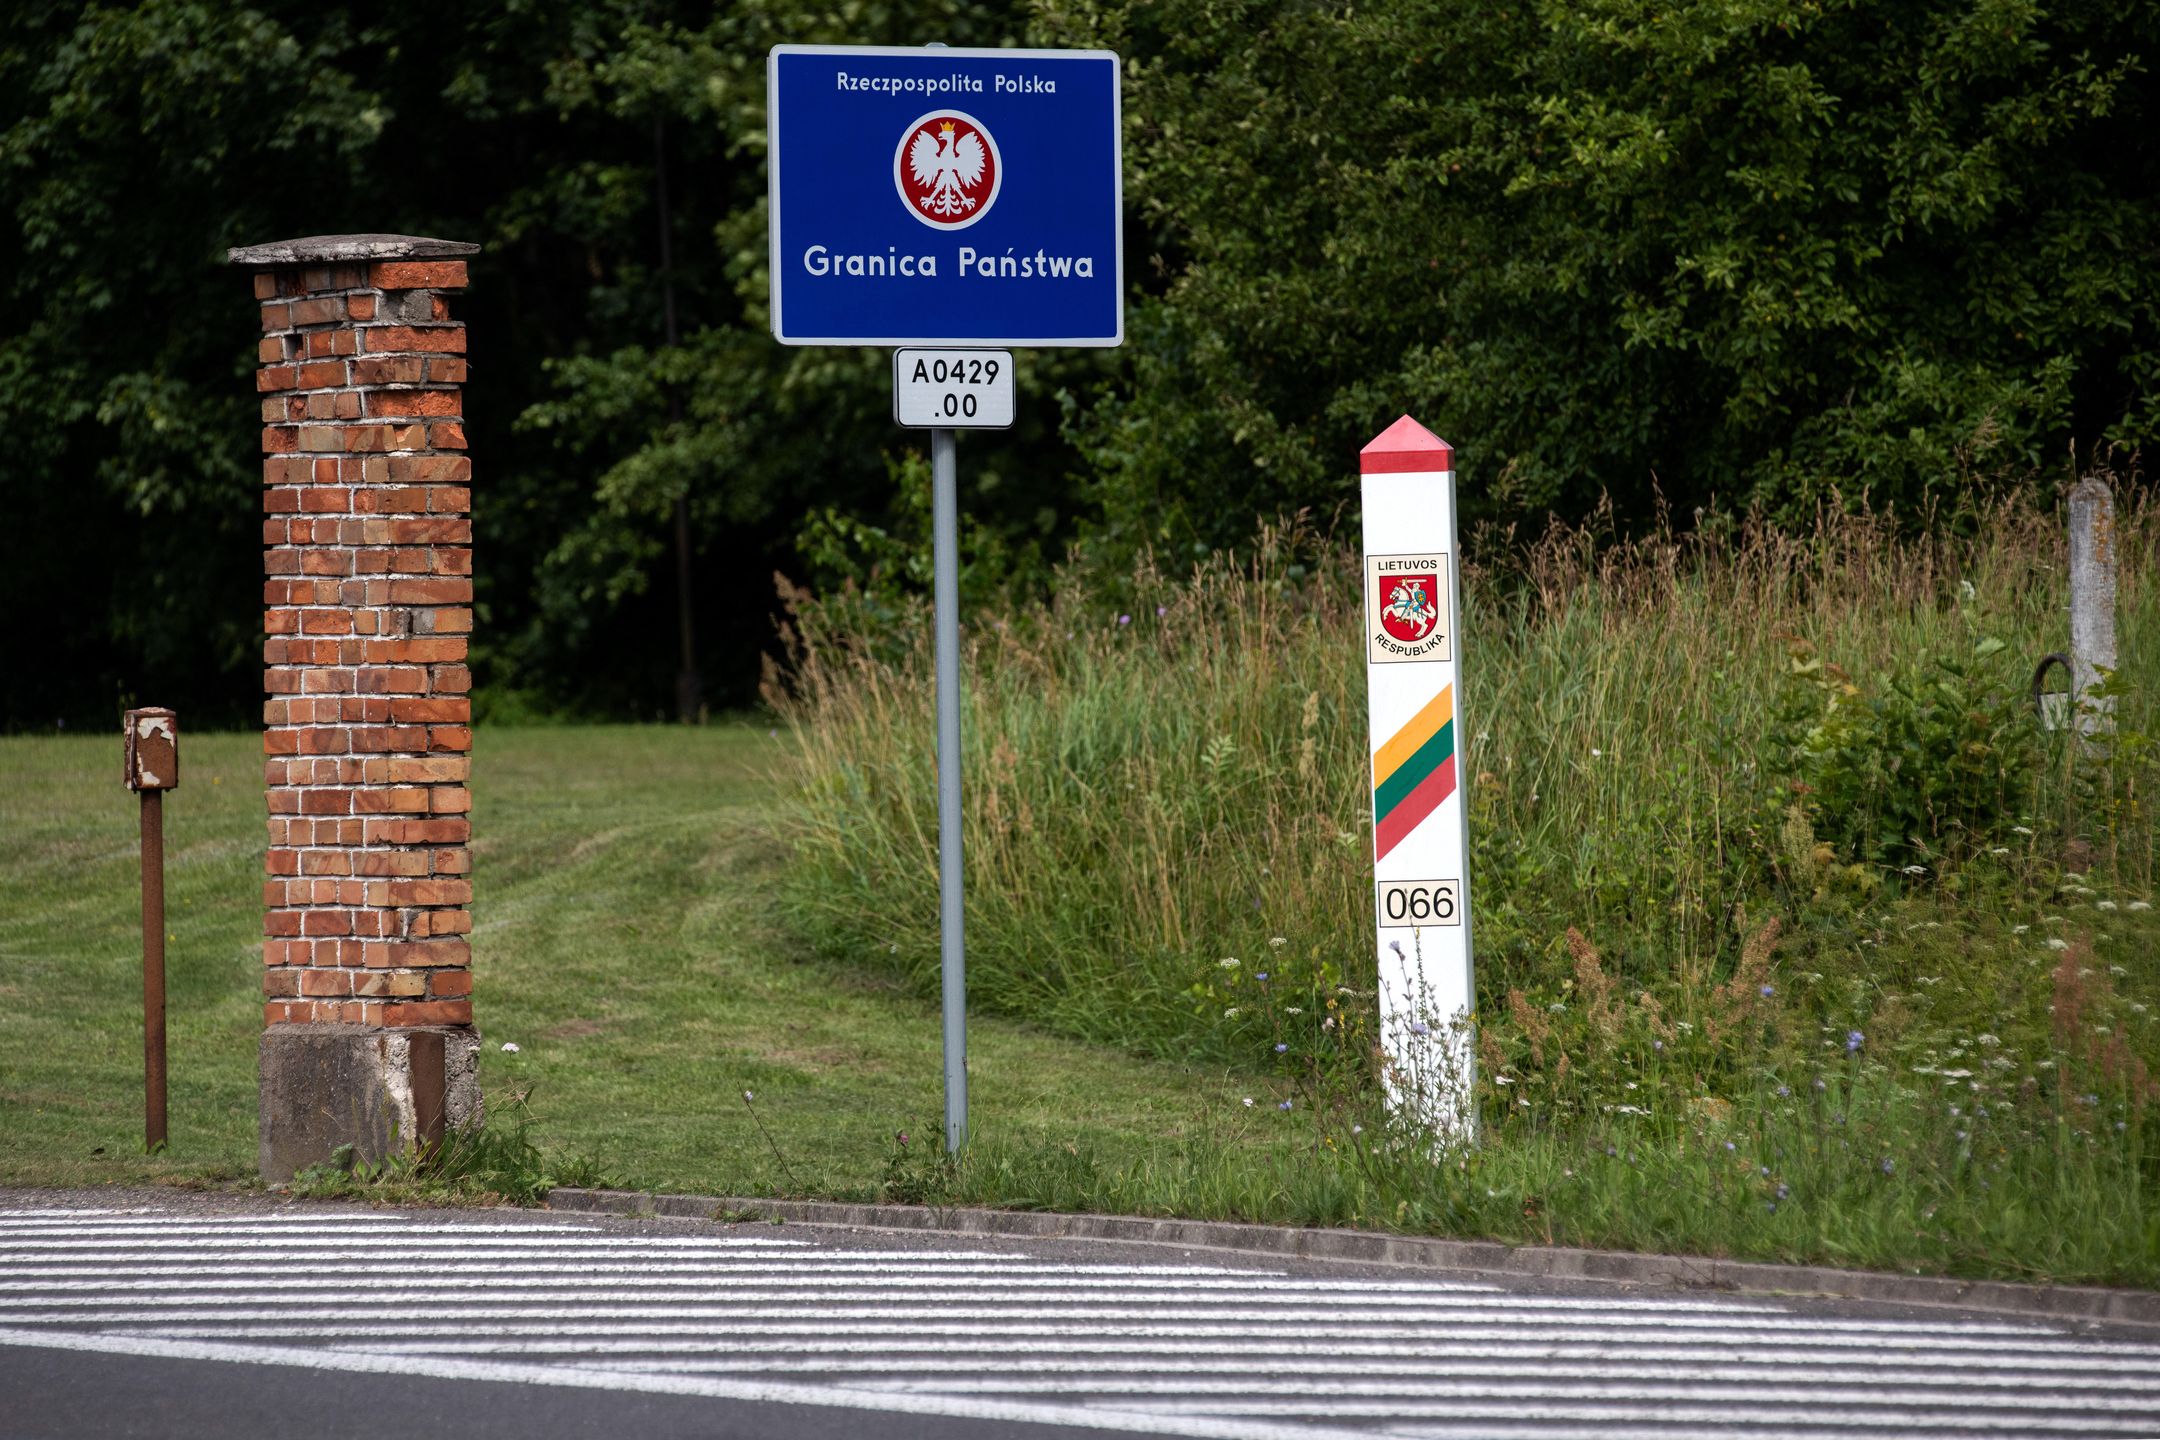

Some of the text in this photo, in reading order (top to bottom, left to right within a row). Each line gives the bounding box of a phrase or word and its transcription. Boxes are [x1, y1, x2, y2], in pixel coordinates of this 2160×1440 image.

[836, 71, 1056, 96] Rzeczpospolita Polska
[804, 244, 1094, 278] Granica Państwa
[912, 358, 1000, 385] A0429
[934, 393, 978, 418] .00
[1378, 559, 1438, 571] LIETUVOS
[1374, 633, 1445, 656] RESPUBLIKA
[1386, 887, 1454, 920] 066
